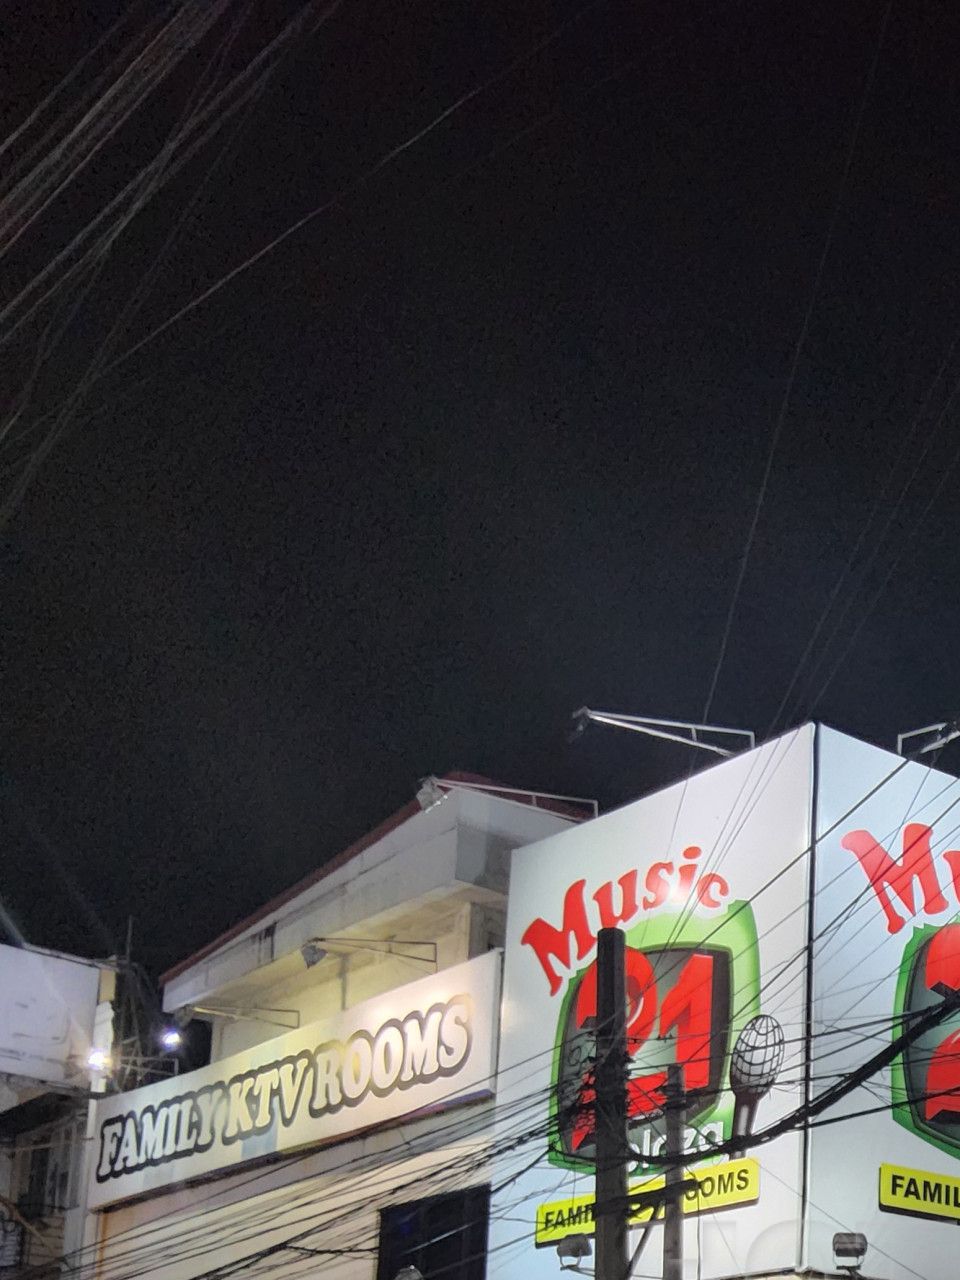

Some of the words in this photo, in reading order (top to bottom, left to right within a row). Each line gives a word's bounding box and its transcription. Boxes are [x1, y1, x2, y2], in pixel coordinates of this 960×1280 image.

[520, 847, 729, 996] Music
[97, 1082, 229, 1182] FAMILY
[221, 1050, 313, 1146] KTV
[307, 995, 474, 1116] ROOMS
[570, 946, 713, 1150] 21
[684, 1168, 750, 1202] OOMS
